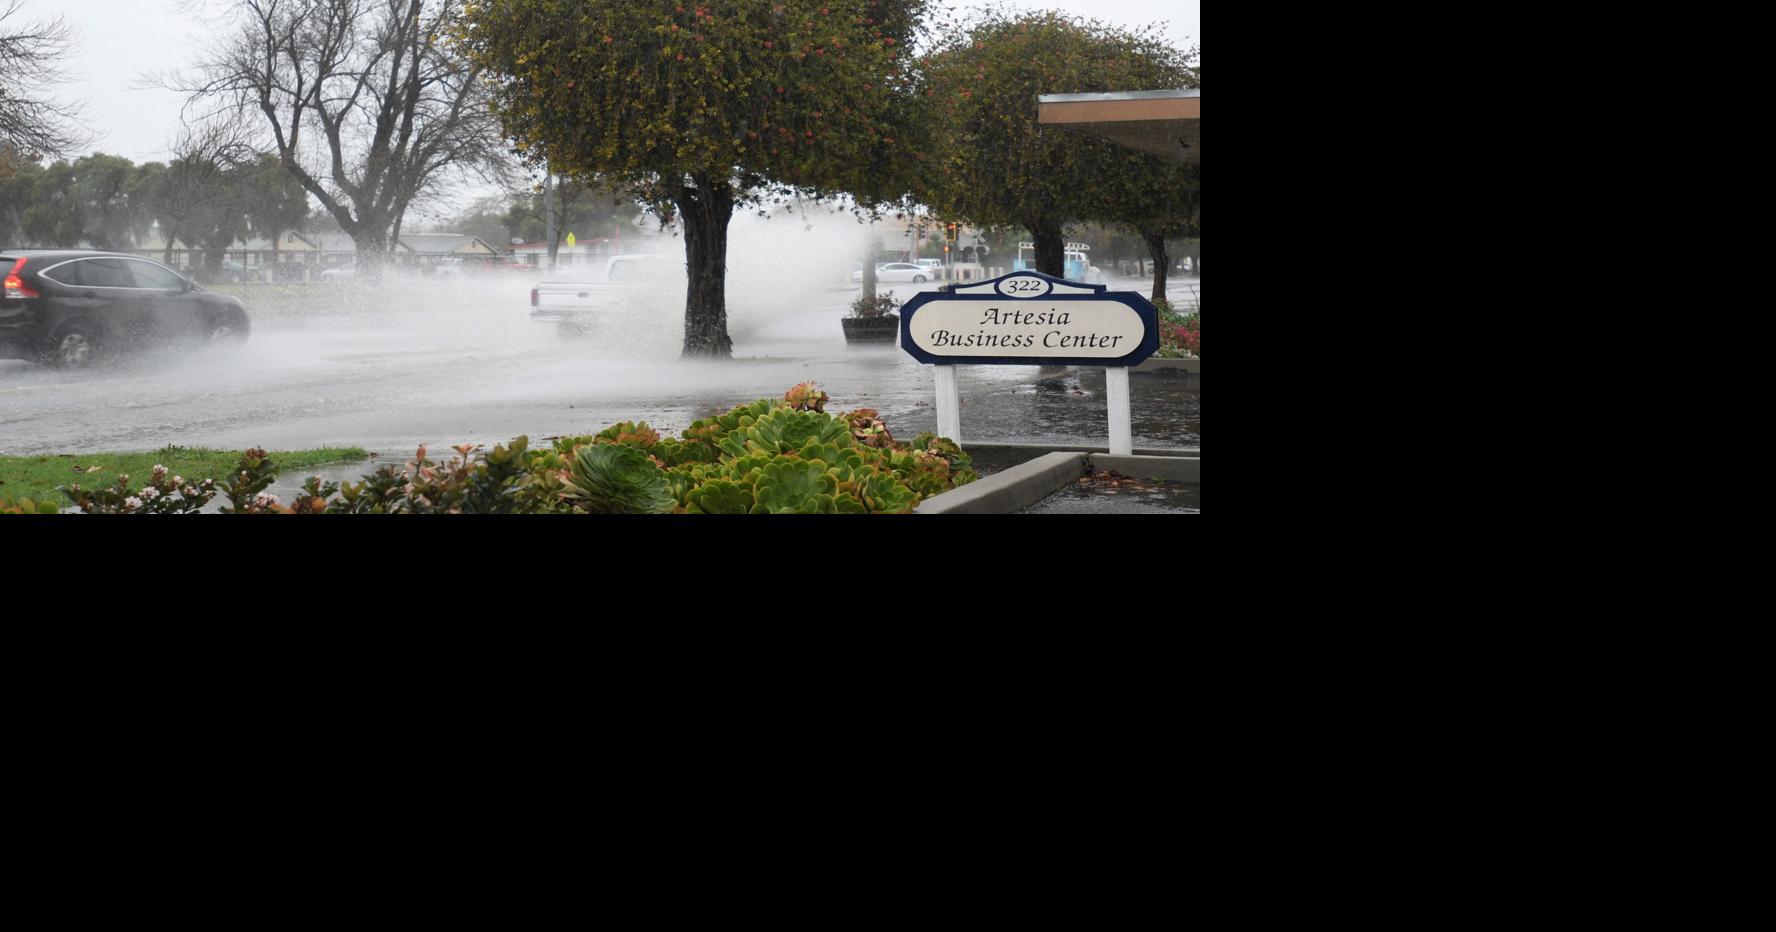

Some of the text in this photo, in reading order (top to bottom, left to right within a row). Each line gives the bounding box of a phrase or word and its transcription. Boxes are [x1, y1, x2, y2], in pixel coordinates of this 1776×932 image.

[1007, 280, 1041, 293] 322
[980, 308, 1071, 326] Artesia
[931, 330, 1123, 349] Business Center
